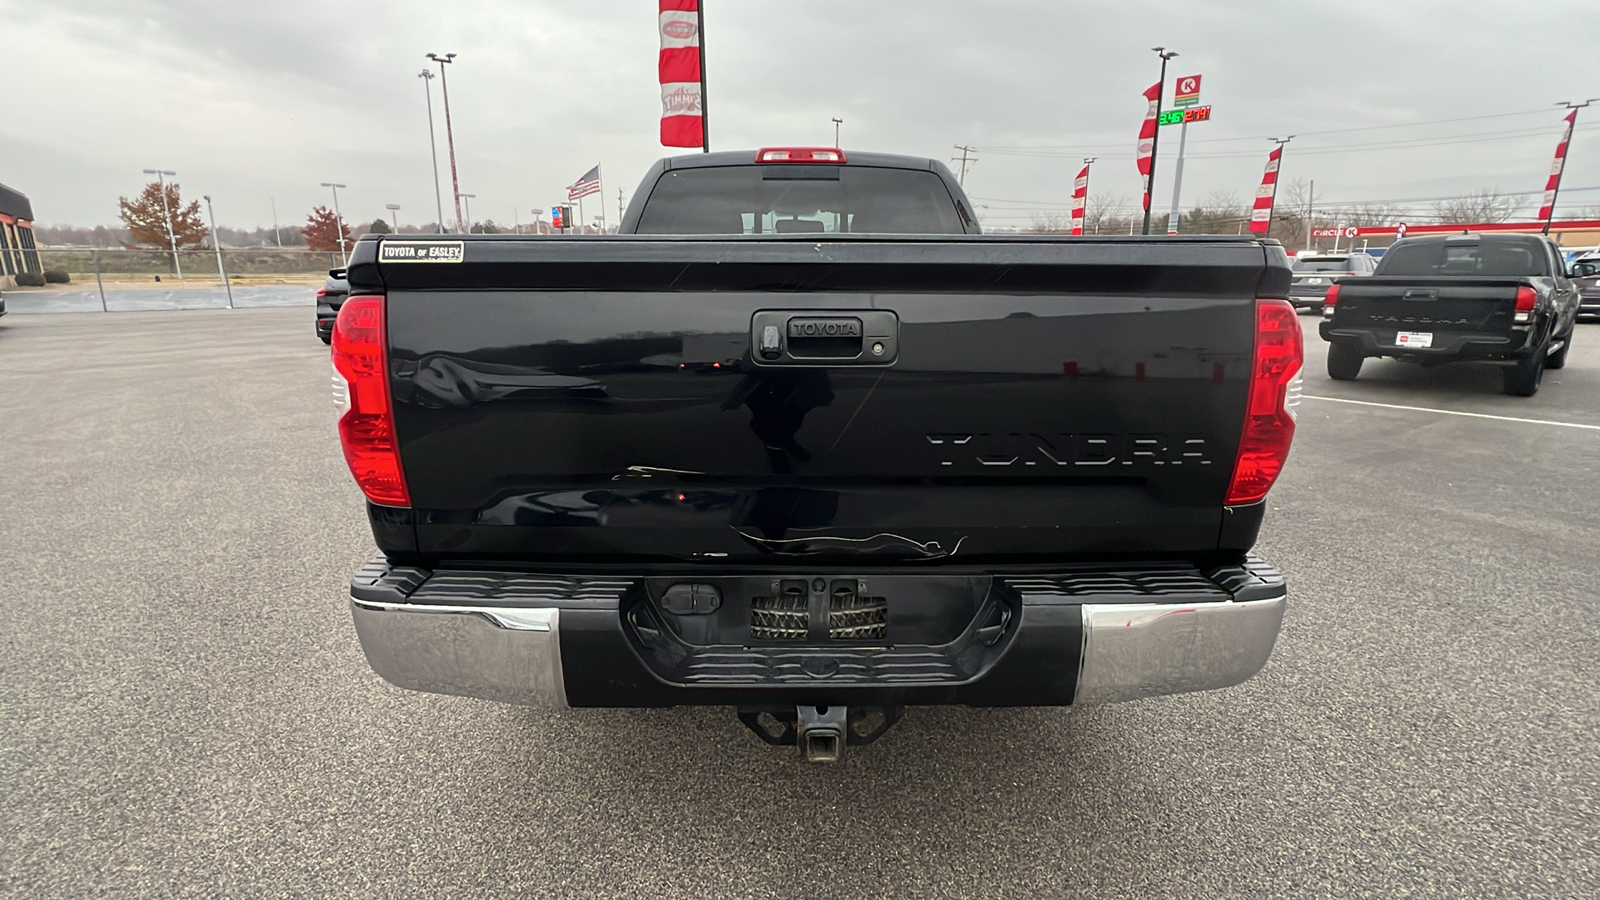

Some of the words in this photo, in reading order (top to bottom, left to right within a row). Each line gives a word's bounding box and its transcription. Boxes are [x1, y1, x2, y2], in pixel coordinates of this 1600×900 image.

[384, 247, 415, 257] TOYOTA
[429, 247, 460, 257] EASLEY
[793, 322, 858, 336] TOYOTA
[926, 433, 1212, 466] TUNDRA
